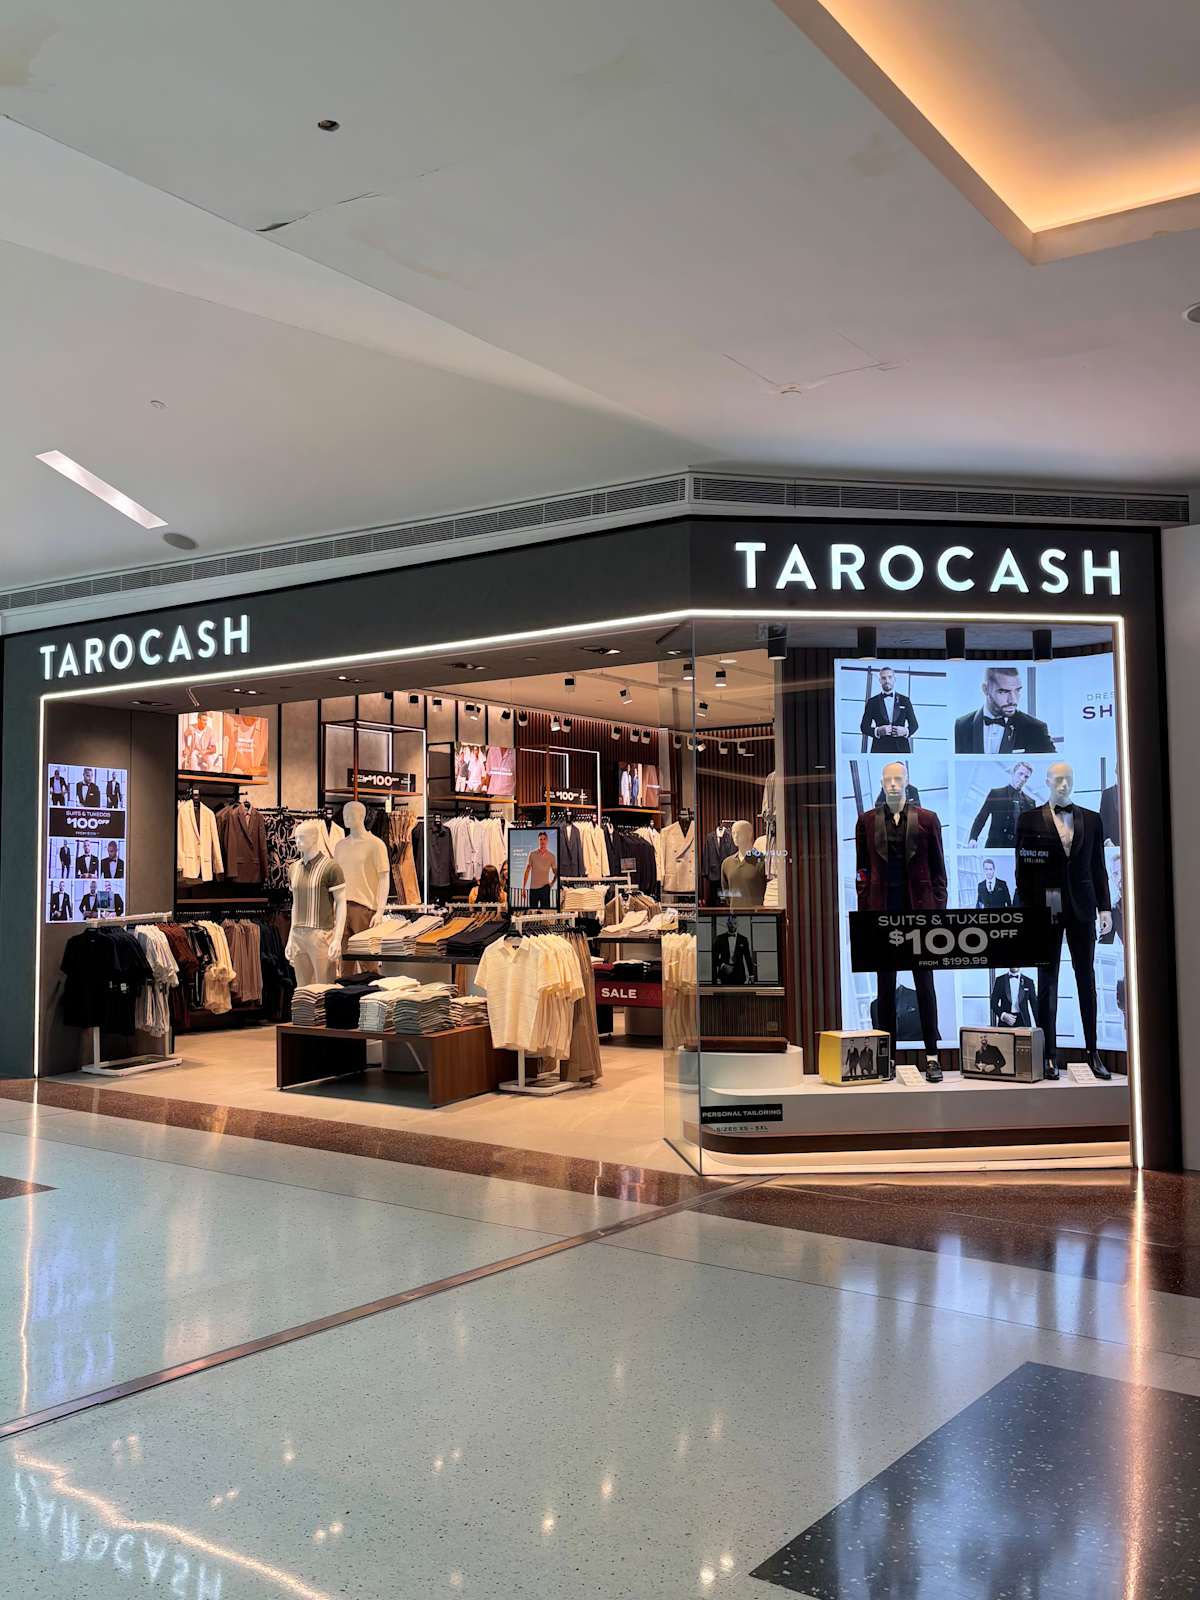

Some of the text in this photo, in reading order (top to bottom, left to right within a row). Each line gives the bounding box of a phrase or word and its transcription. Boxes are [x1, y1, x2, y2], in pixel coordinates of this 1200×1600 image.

[735, 541, 1121, 596] TAROCASH
[39, 614, 250, 680] TAROCASH
[1082, 704, 1112, 720] SH
[66, 817, 98, 829] $100
[878, 912, 1024, 927] SUITS & TUXEDOS
[889, 927, 1018, 955] $100 OFF
[942, 956, 988, 966] $199.99
[601, 987, 637, 999] SALE
